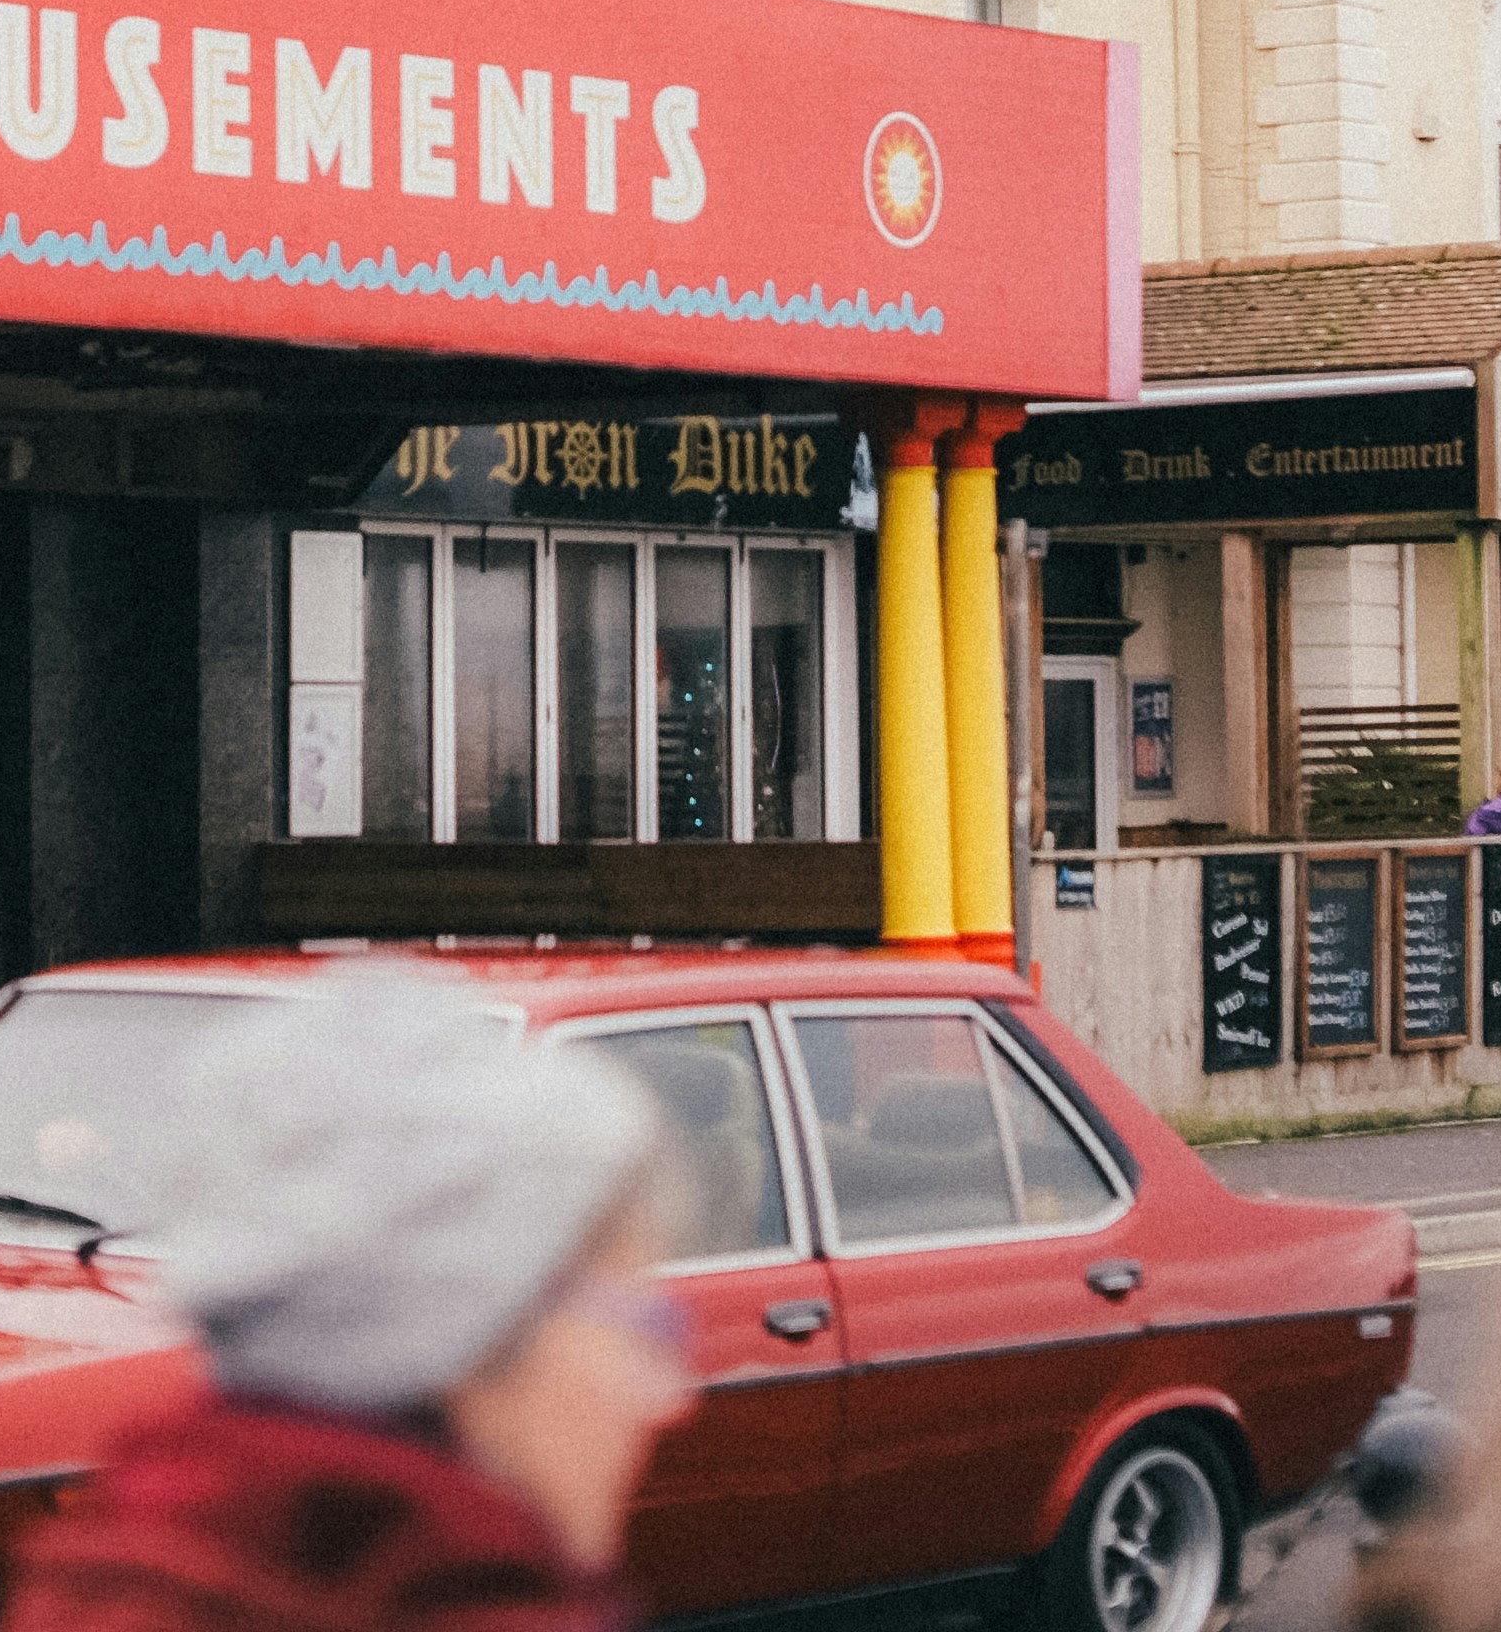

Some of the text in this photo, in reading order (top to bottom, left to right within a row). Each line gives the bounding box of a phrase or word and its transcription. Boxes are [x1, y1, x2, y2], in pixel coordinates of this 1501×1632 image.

[667, 413, 817, 497] Duke
[1009, 438, 1465, 492] Food Drink Entertainment
